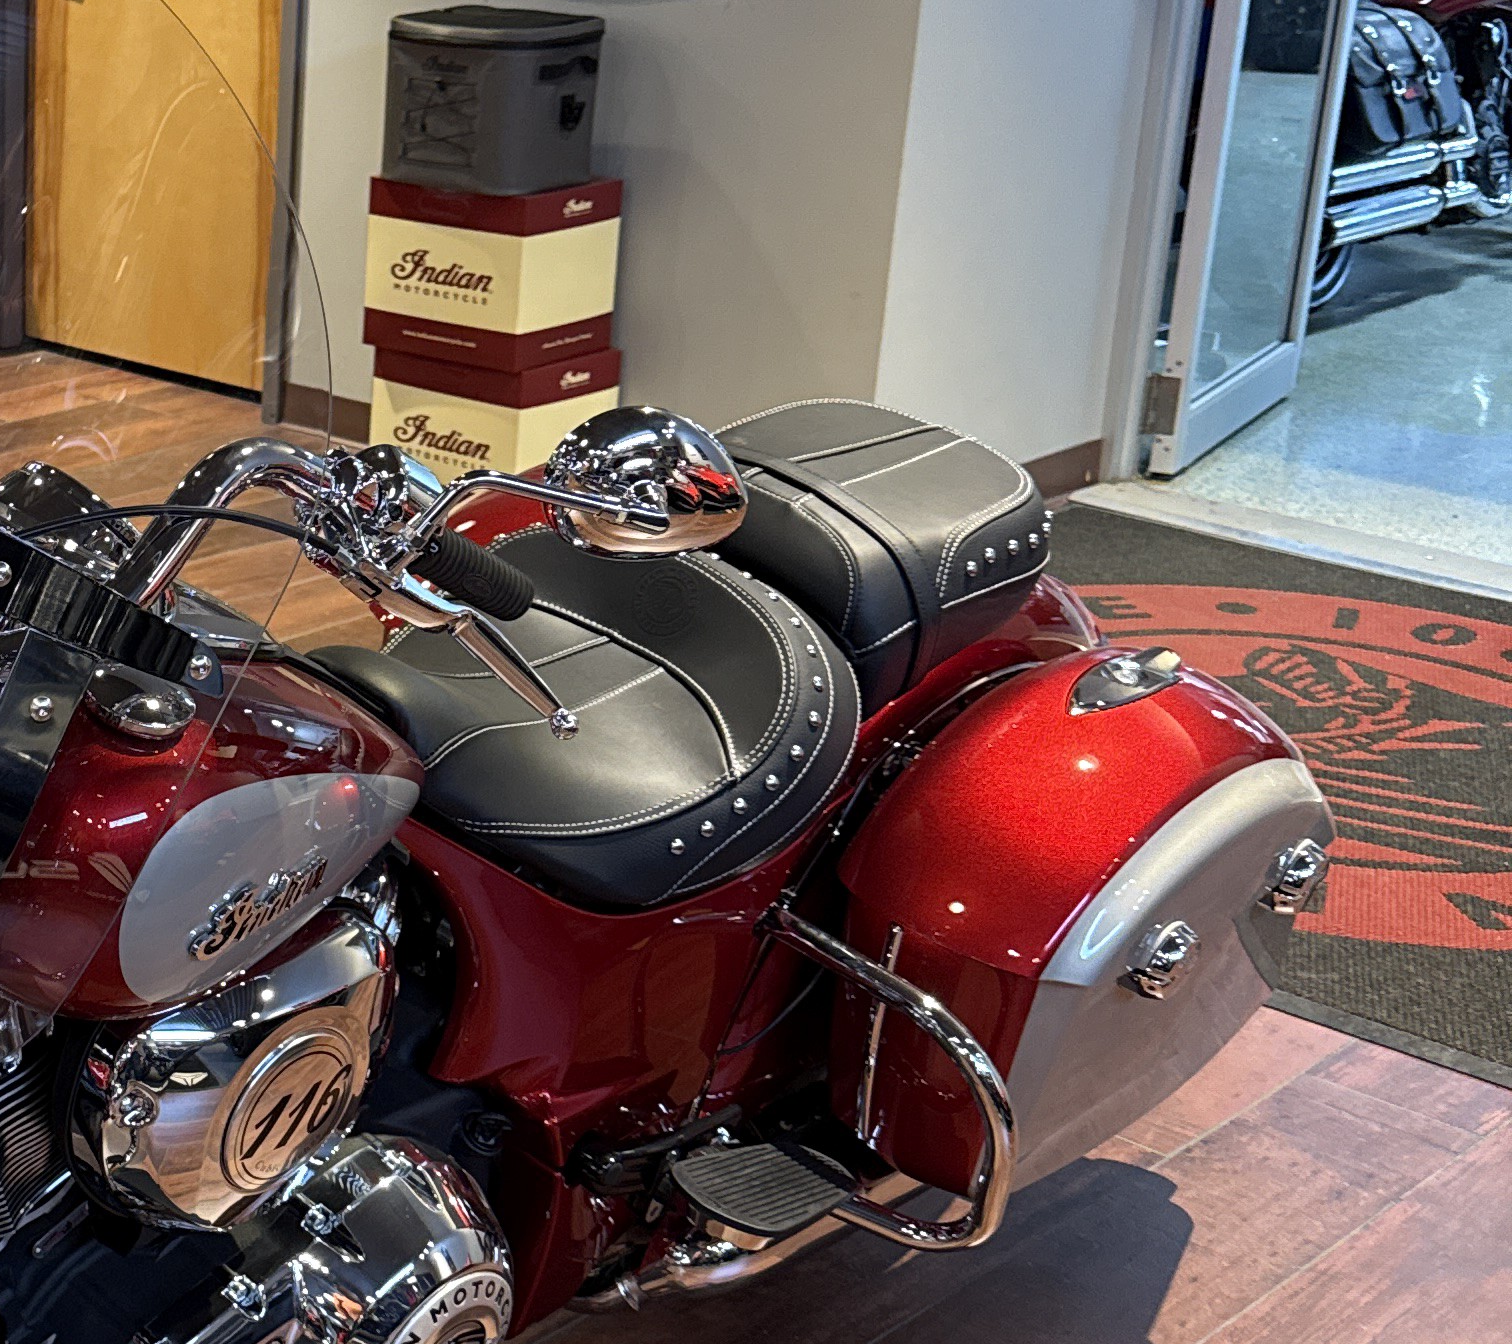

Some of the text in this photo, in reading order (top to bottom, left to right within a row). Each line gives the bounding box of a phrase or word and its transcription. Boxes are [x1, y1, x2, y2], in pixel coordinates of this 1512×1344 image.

[390, 249, 493, 293] Indian
[393, 282, 488, 306] MOTORCYCLE
[393, 414, 490, 461] Indian
[188, 853, 329, 961] Indian
[239, 1063, 352, 1161] 116
